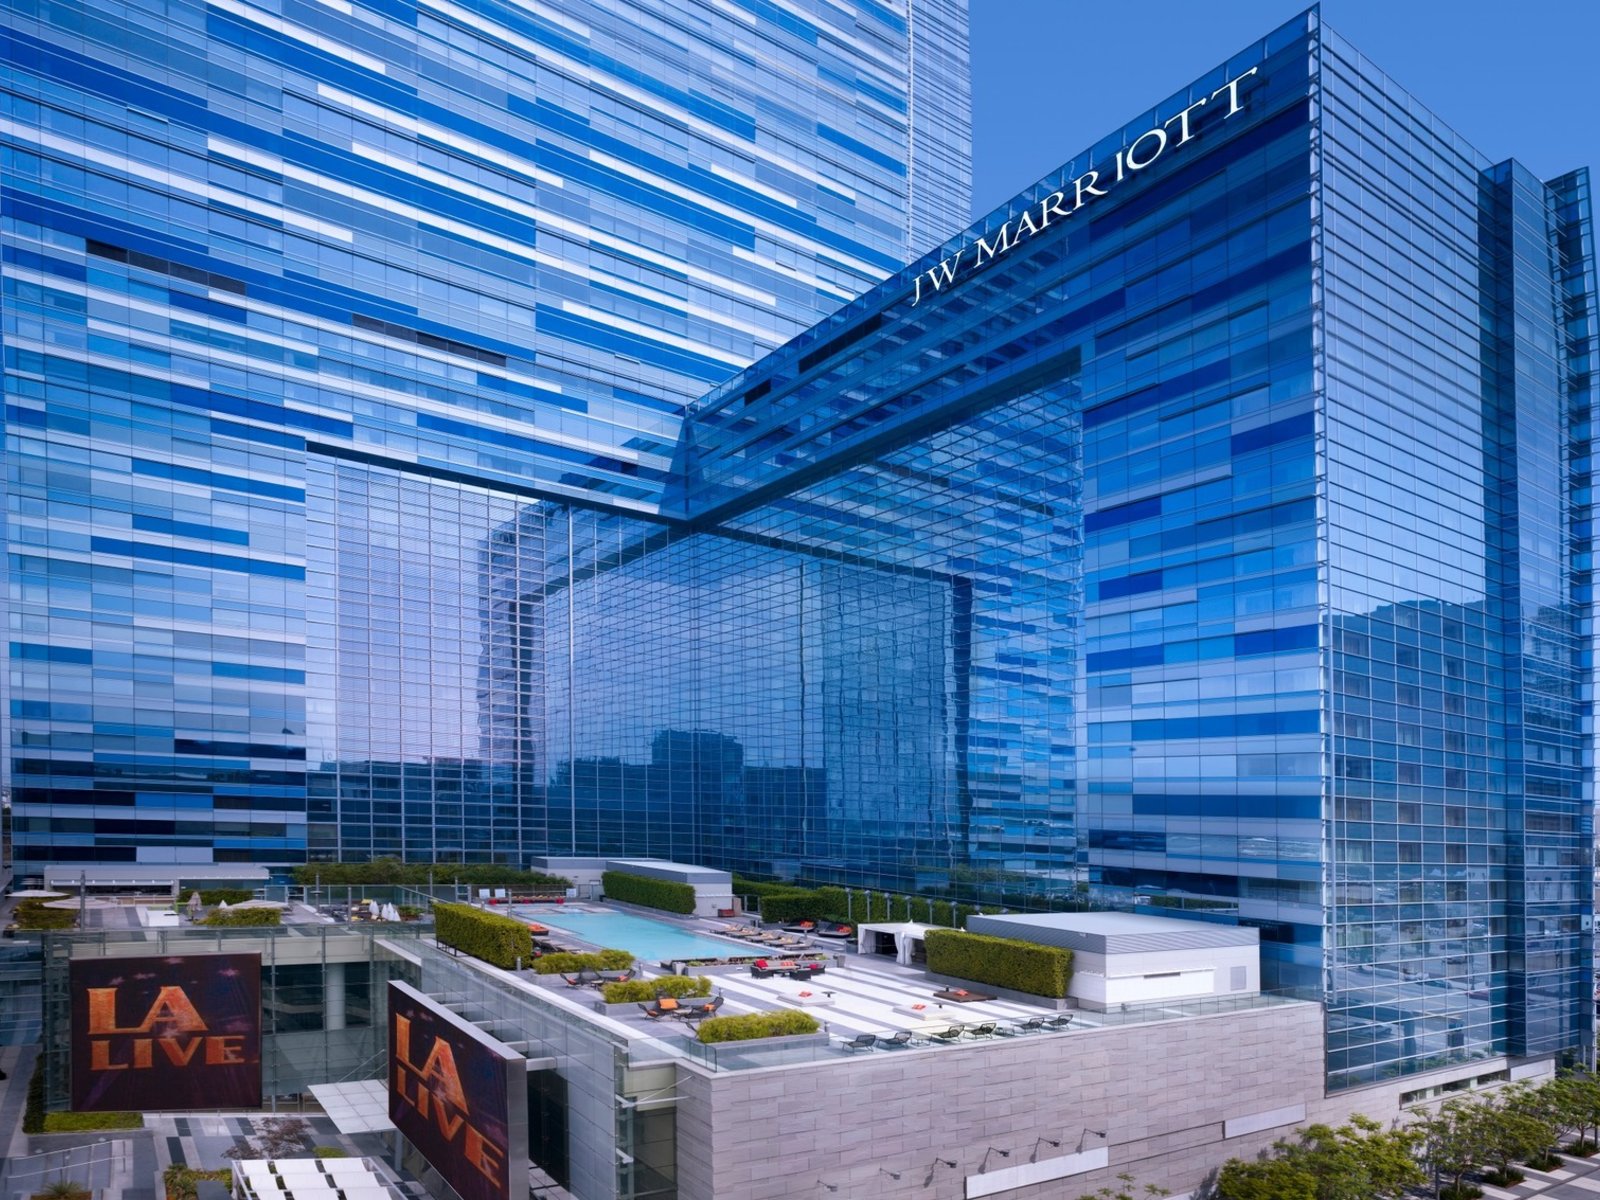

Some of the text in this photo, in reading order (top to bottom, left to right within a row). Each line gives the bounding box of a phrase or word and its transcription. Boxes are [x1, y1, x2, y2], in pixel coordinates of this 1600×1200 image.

[912, 66, 1258, 307] JW MARRIOTT
[87, 985, 209, 1035] LA
[90, 1035, 246, 1071] LIVE
[396, 1012, 470, 1117] LA
[396, 1064, 504, 1190] LIVE
